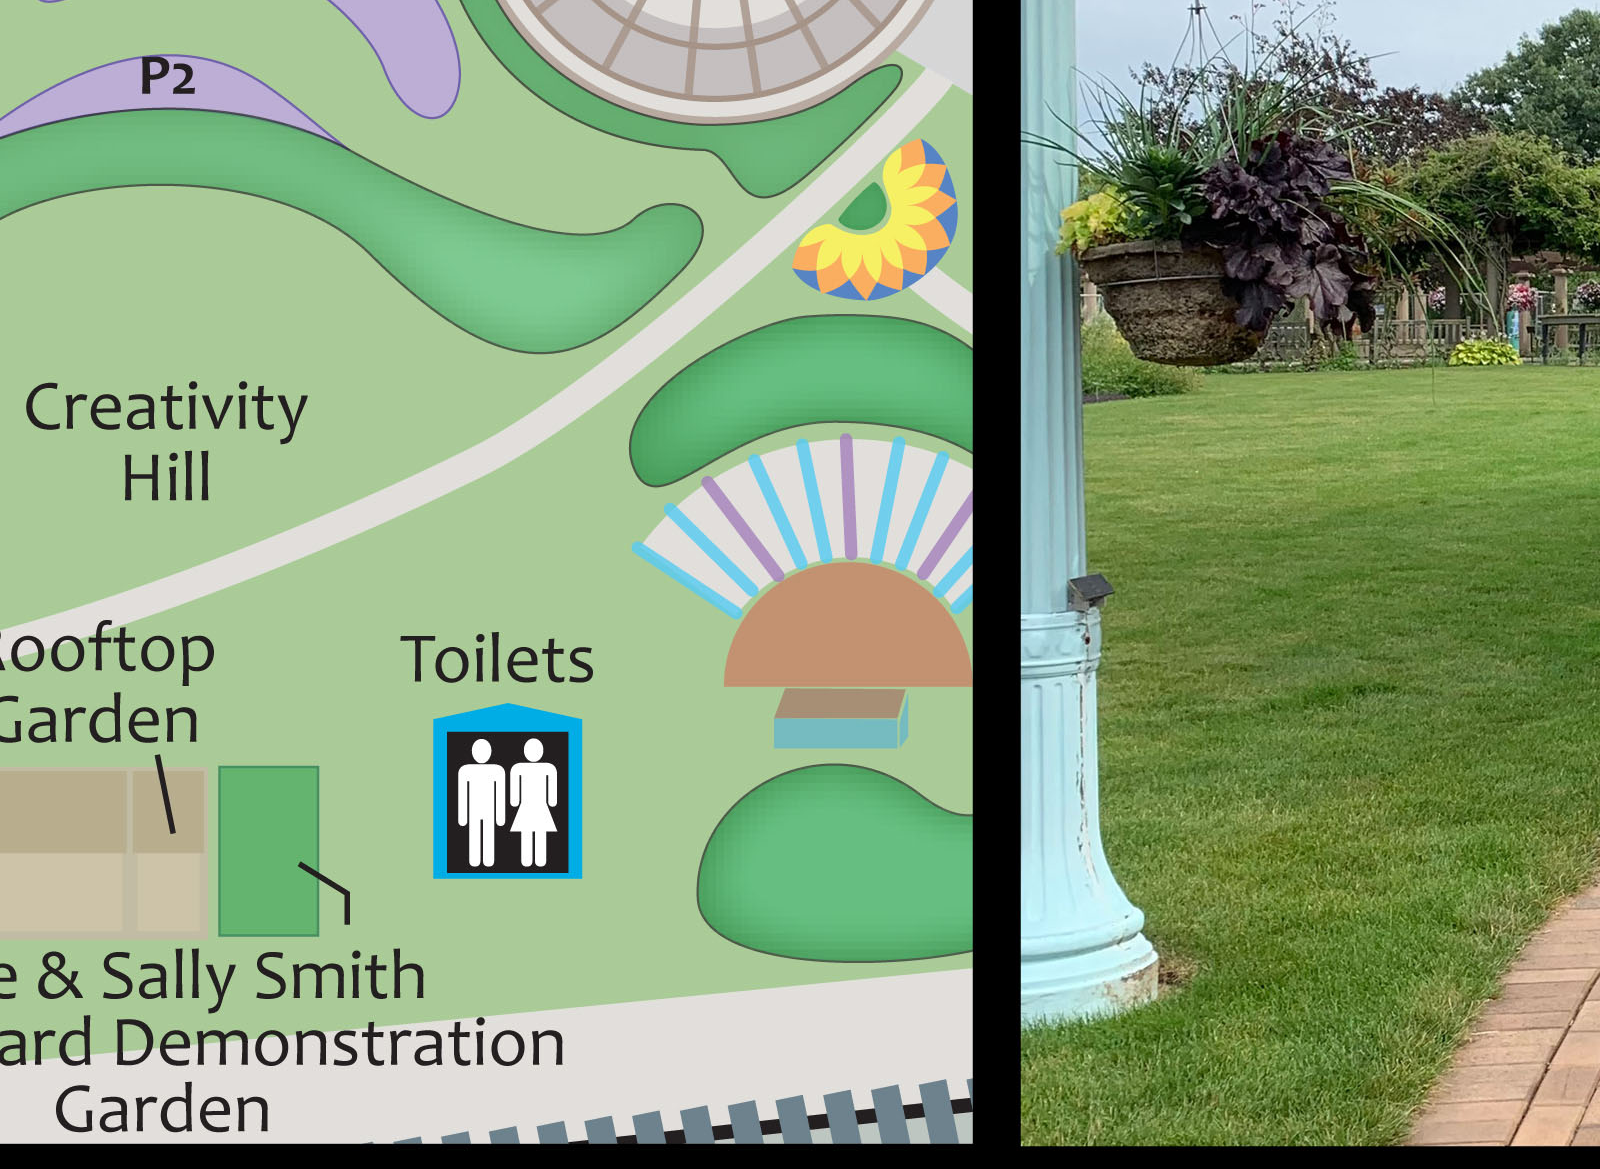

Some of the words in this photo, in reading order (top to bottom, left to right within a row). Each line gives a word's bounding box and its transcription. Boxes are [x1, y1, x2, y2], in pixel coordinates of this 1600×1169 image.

[140, 56, 197, 95] P2
[24, 380, 309, 445] Creativity
[123, 450, 210, 501] Hill
[399, 631, 595, 684] Toilets
[36, 951, 85, 1000] &
[102, 948, 237, 1014] Sally
[255, 948, 425, 1000] Smith
[115, 1017, 564, 1067] Demonstration
[54, 1081, 269, 1133] Garden
